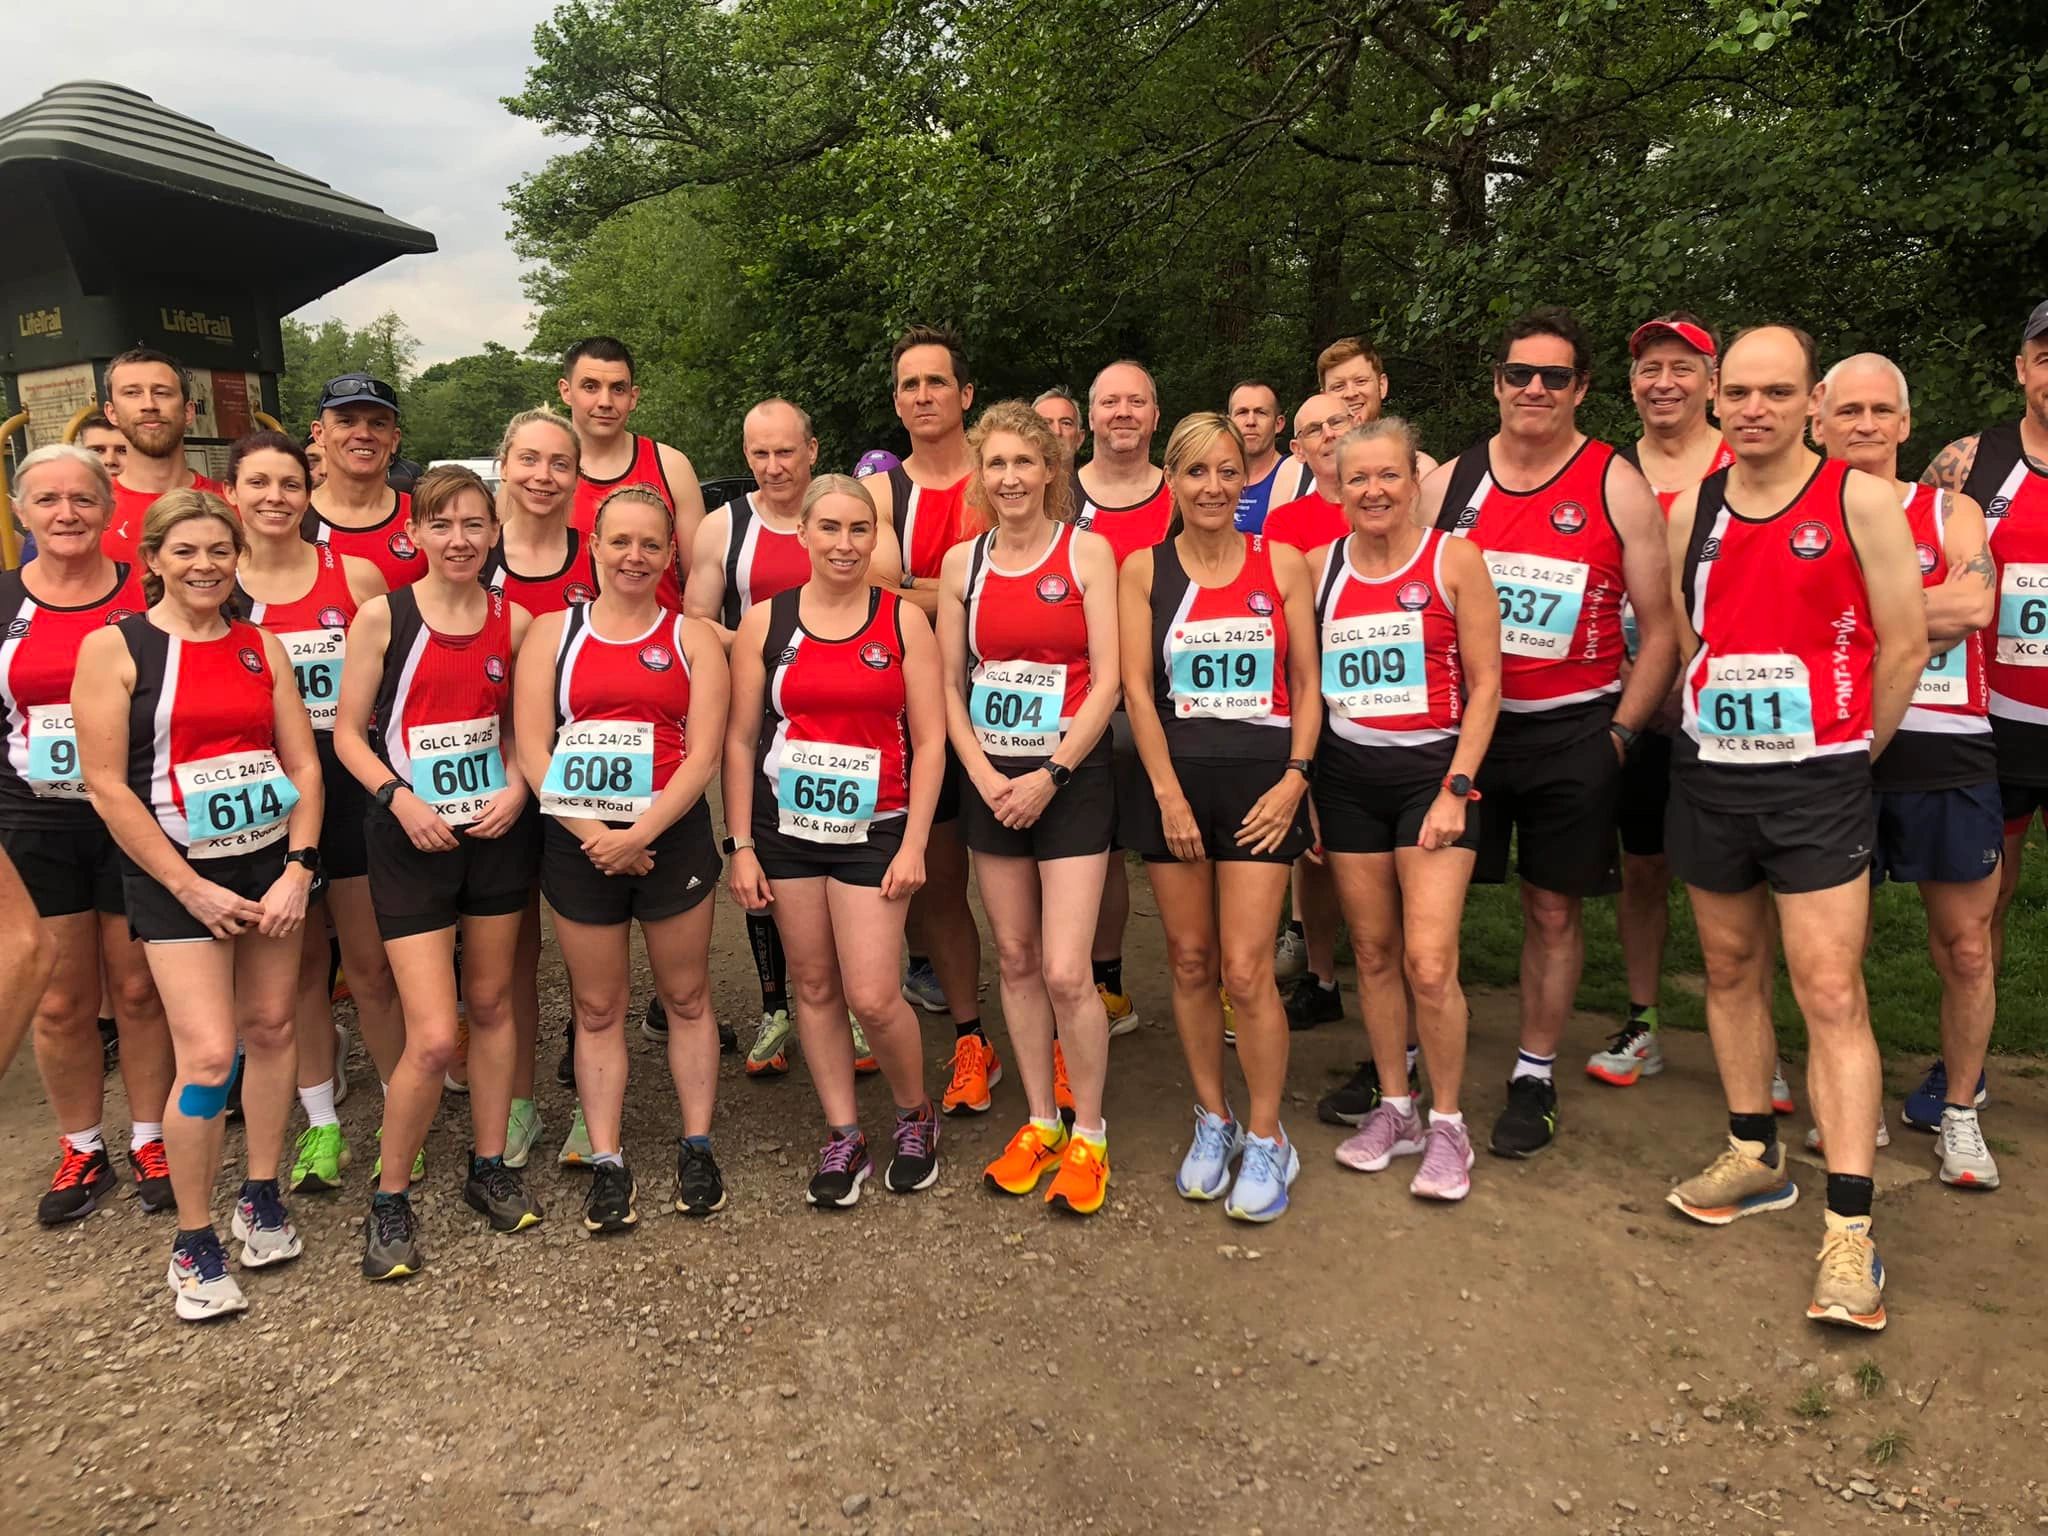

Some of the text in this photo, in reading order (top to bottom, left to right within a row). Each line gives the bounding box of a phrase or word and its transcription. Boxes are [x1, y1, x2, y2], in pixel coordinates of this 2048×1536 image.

[19, 306, 62, 337] LifeTrail
[160, 307, 232, 337] LifeTrail
[1491, 564, 1574, 585] GLCL 24/25
[2016, 576, 2048, 588] GLC
[1495, 586, 1562, 627] 637
[2020, 598, 2048, 635] 6
[1183, 630, 1265, 644] GLCL 24/25
[1330, 624, 1411, 644] GLCL 24/25
[1505, 630, 1556, 648] & Road
[292, 642, 336, 655] 24/25
[2014, 642, 2038, 655] XC
[1191, 653, 1257, 689] 619
[1339, 647, 1406, 688] 609
[1714, 669, 1743, 681] LCL
[294, 664, 333, 699] 46
[985, 671, 1055, 687] GLCL 24/25
[1191, 696, 1257, 708] XC & Road
[1337, 691, 1411, 707] XC & Road
[985, 691, 1043, 728] 604
[1714, 692, 1783, 731] 611
[42, 717, 75, 729] GLC
[419, 729, 493, 750] GLCL 24/25
[598, 733, 642, 746] 24/25
[983, 731, 1045, 747] XC & Road
[1716, 738, 1796, 751] XC & Road
[50, 740, 75, 775] 9
[791, 752, 825, 767] GLCL
[829, 756, 870, 772] 24/25
[193, 761, 276, 785] GLCL 24/25
[432, 752, 491, 796] 607
[563, 755, 633, 792] 608
[48, 782, 87, 792] XC &
[794, 774, 860, 815] 656
[208, 783, 283, 831] 614
[434, 803, 457, 815] XC
[461, 802, 471, 813] &
[557, 797, 633, 812] XC & Road
[792, 814, 857, 834] XC & Road
[209, 839, 233, 848] XC
[236, 834, 247, 845] &
